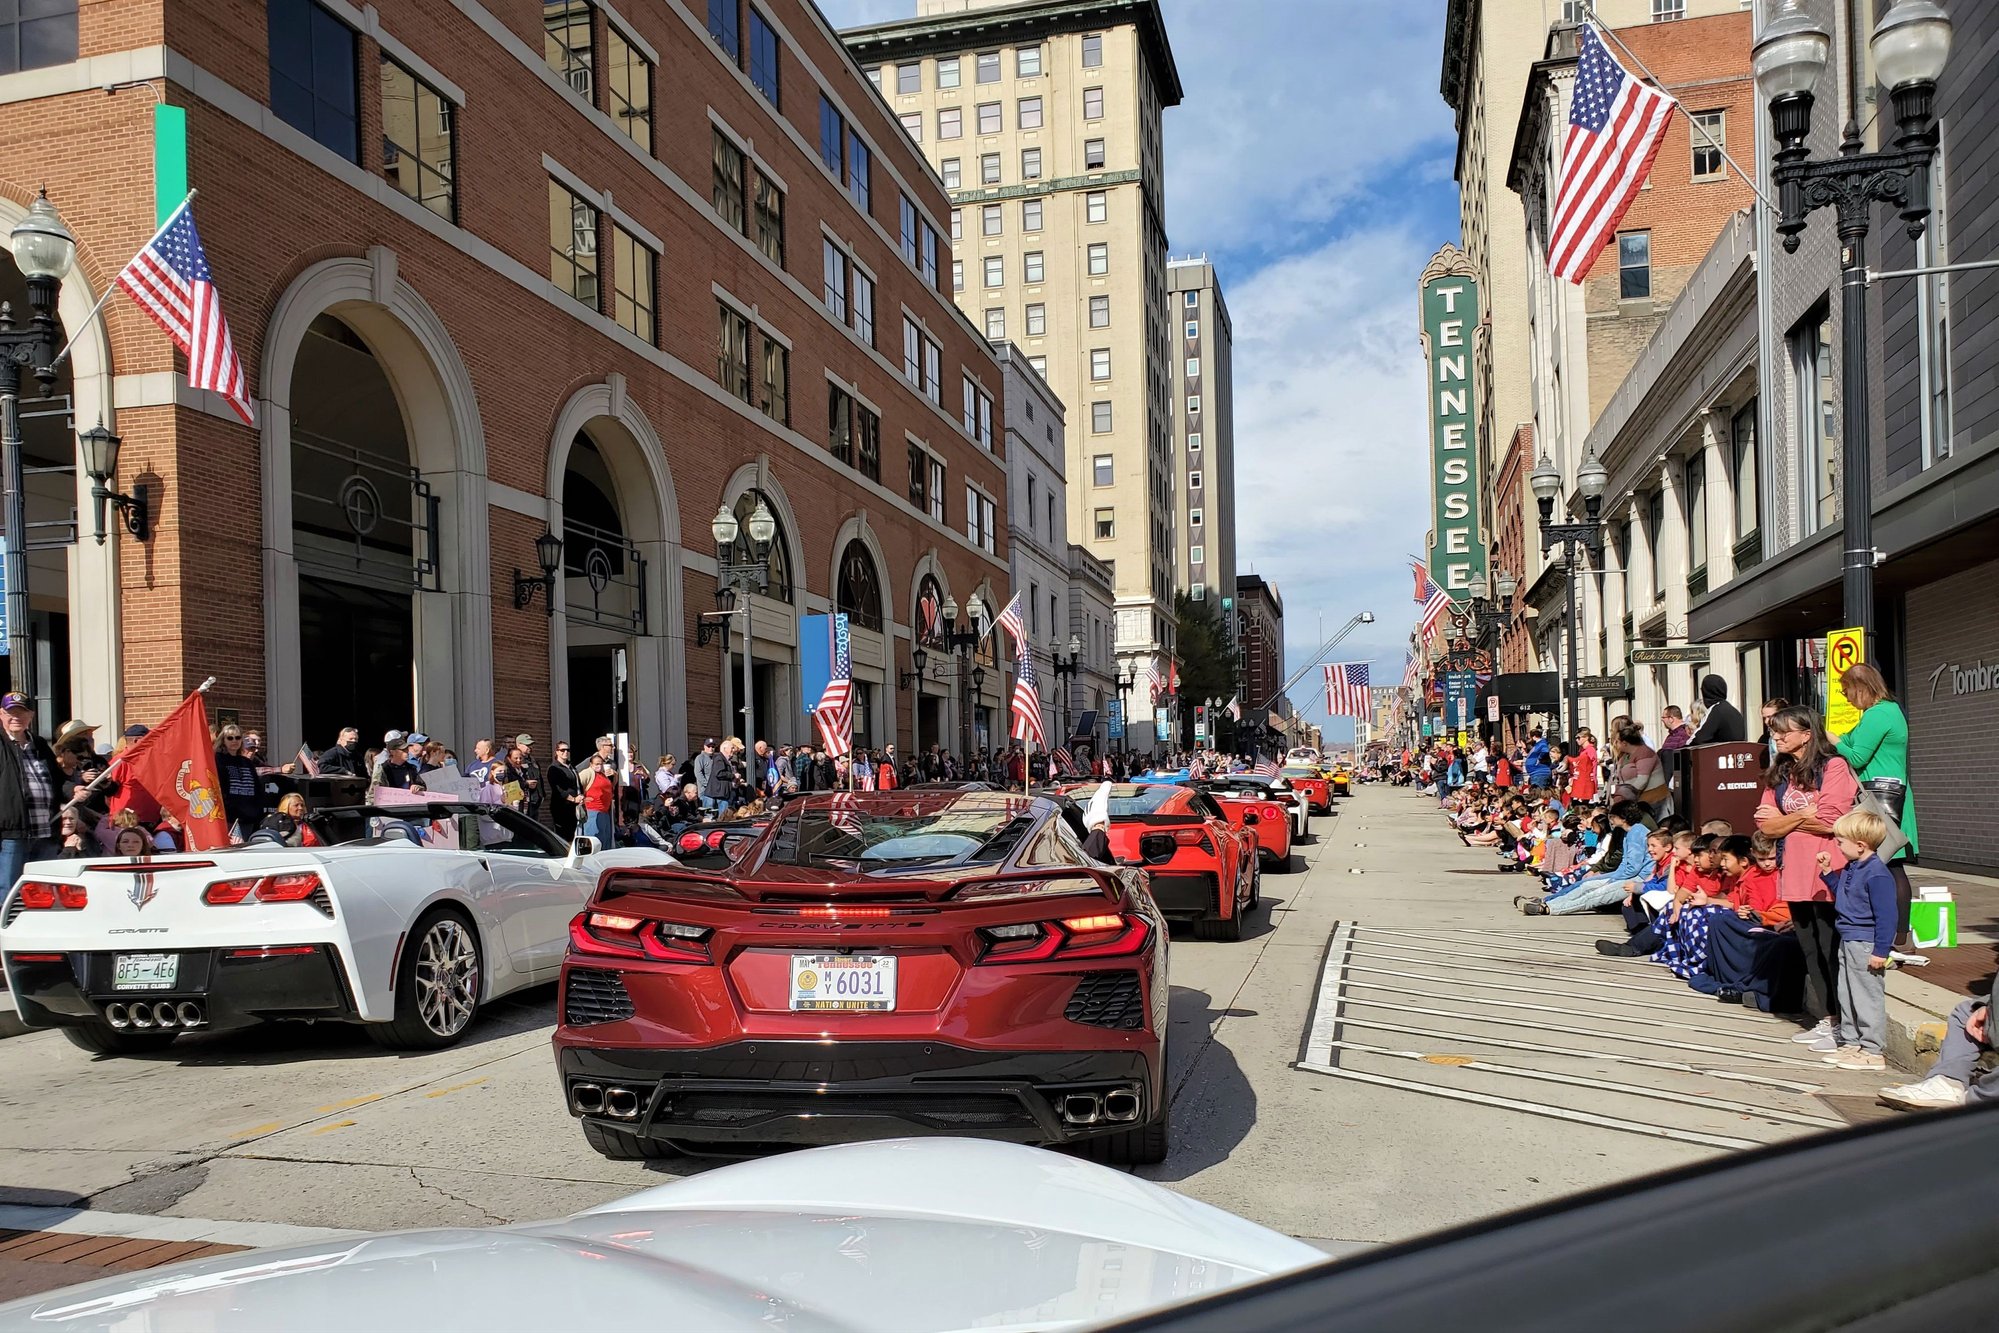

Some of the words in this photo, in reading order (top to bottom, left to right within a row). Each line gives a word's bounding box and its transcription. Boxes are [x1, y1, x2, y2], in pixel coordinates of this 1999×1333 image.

[1436, 285, 1470, 590] TENNESSEE
[1634, 651, 1656, 660] Rick
[1657, 650, 1682, 662] Terry
[1726, 782, 1758, 790] RECYCLING
[758, 921, 926, 931] CORVETTE
[836, 971, 884, 995] 6031
[846, 1001, 869, 1009] UNITE
